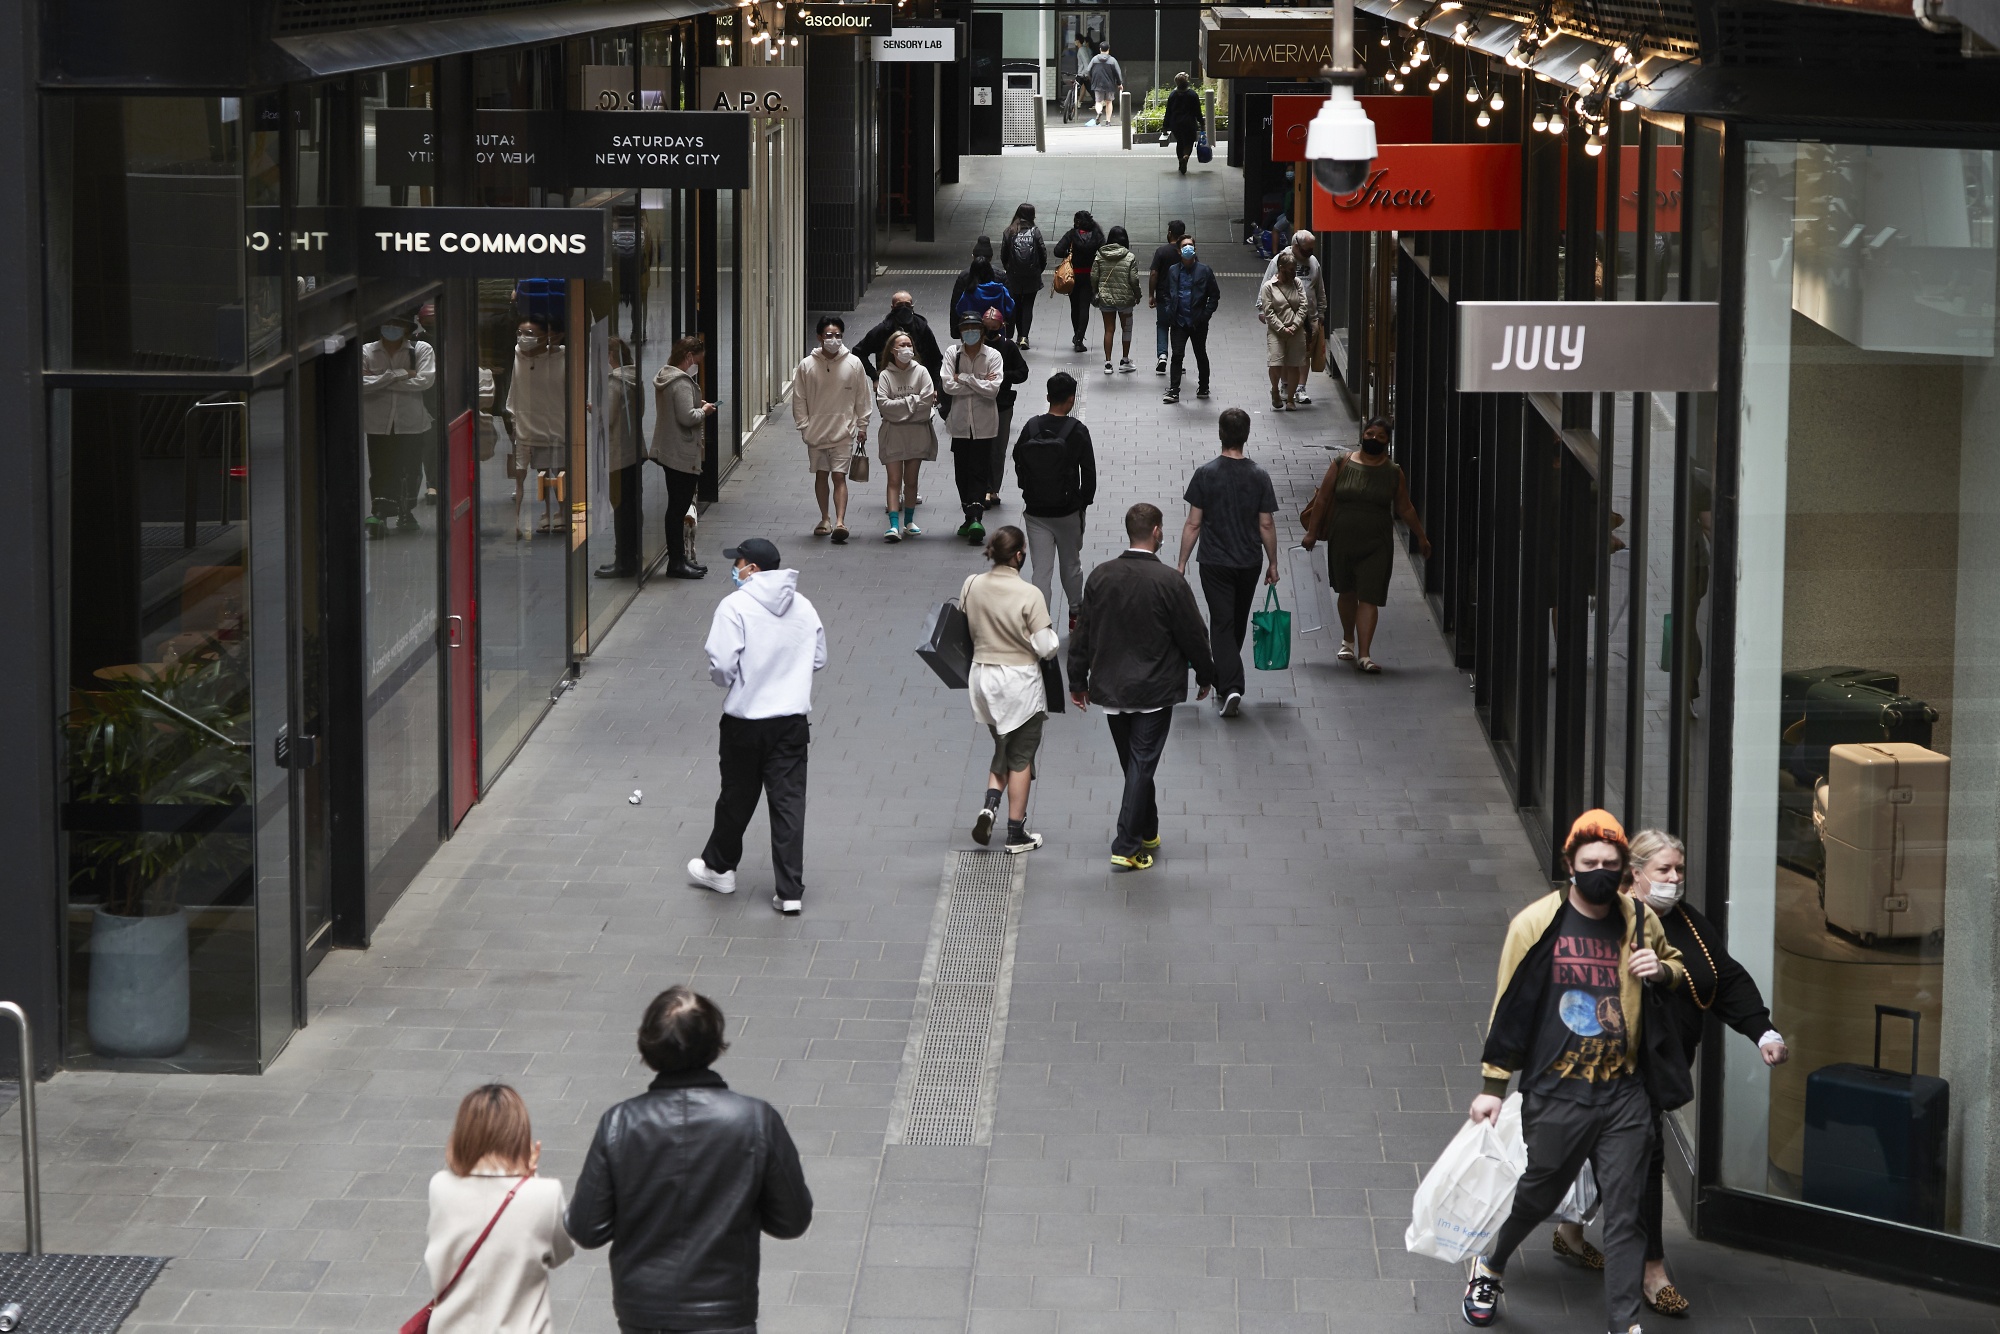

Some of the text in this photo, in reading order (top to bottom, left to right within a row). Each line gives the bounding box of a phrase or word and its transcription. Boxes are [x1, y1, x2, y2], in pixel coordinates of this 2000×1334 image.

[805, 12, 873, 27] ascolour.
[883, 40, 942, 49] SENSORY LAB
[1218, 43, 1368, 63] ZIMMERMAN
[713, 91, 788, 113] A.P.C.
[612, 135, 704, 148] SATURDAYS
[595, 153, 721, 165] NEW YORK CITY
[1332, 168, 1435, 208] Incu
[375, 231, 587, 255] THE COMMONS
[1491, 325, 1586, 371] JULY
[1552, 963, 1620, 987] ENEM
